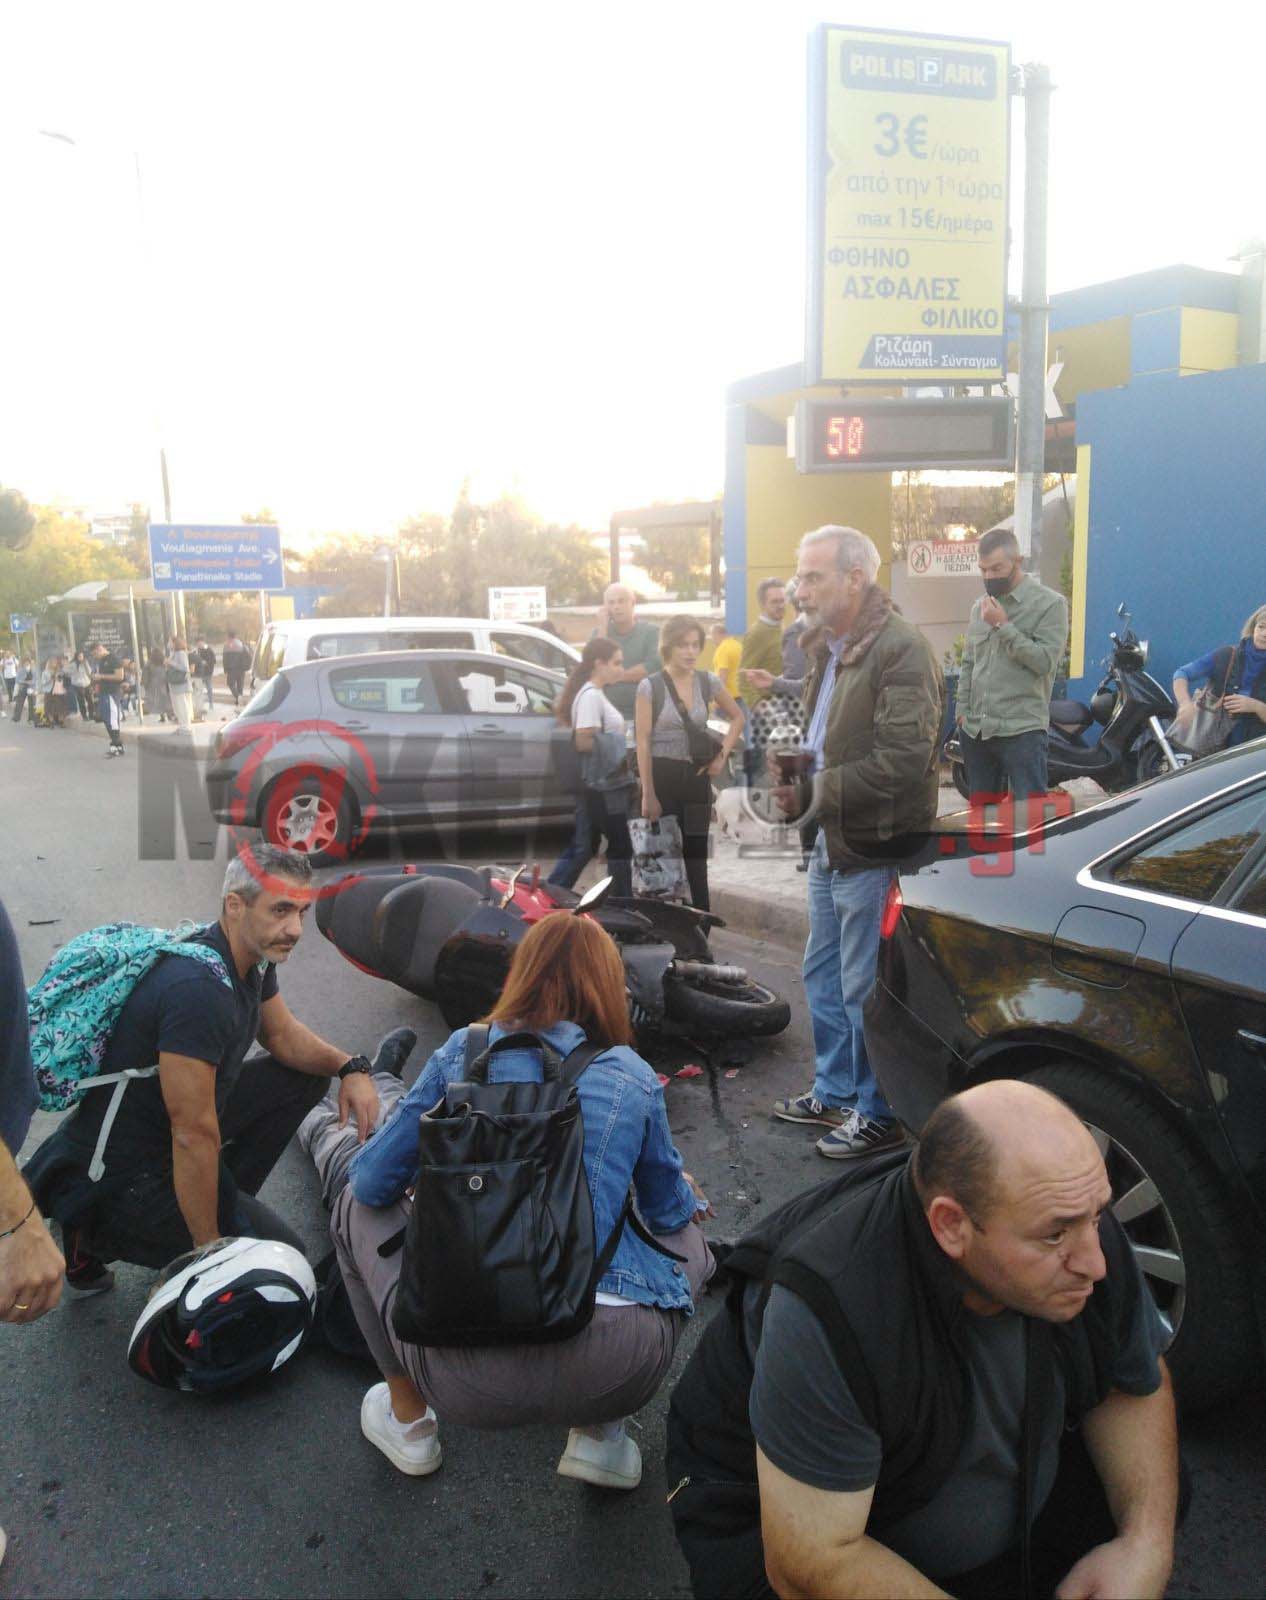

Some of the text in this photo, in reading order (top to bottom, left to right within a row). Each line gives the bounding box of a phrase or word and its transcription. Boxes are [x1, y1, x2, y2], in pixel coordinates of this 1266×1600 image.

[848, 169, 889, 193] από
[896, 176, 929, 201] την
[957, 177, 1002, 204] ώρα
[857, 211, 892, 227] max
[828, 246, 910, 269] ΦΘΗΝΟ
[842, 275, 961, 301] ΑΣΦΑΛΕΣ
[921, 306, 999, 329] ΦΙΛΙΚΟ
[875, 336, 933, 358] Ριζάρη
[941, 355, 998, 370] Σύνταγμα
[826, 416, 865, 456] 50
